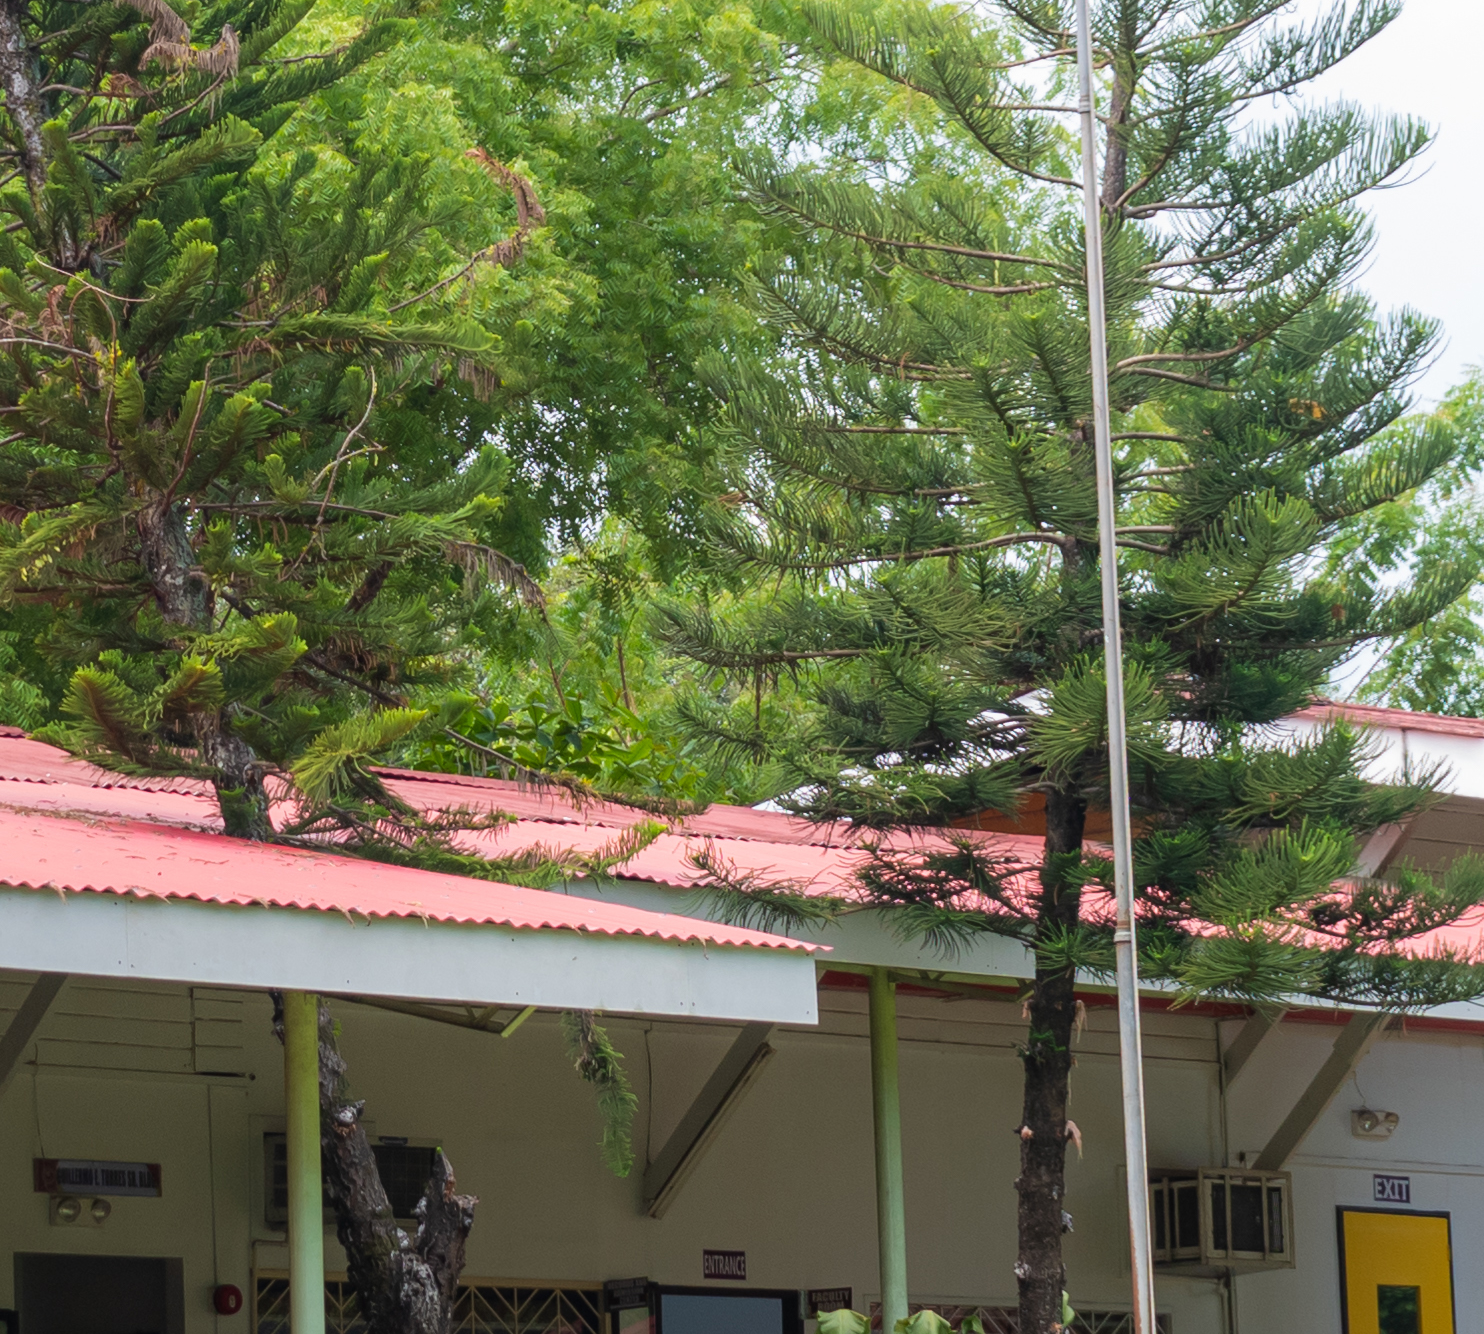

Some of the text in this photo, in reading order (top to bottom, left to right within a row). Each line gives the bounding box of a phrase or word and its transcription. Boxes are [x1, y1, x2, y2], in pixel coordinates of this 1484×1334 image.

[1374, 1178, 1409, 1200] EXIT
[704, 1254, 745, 1277] ENTRANCE
[812, 1290, 849, 1302] FACULTY
